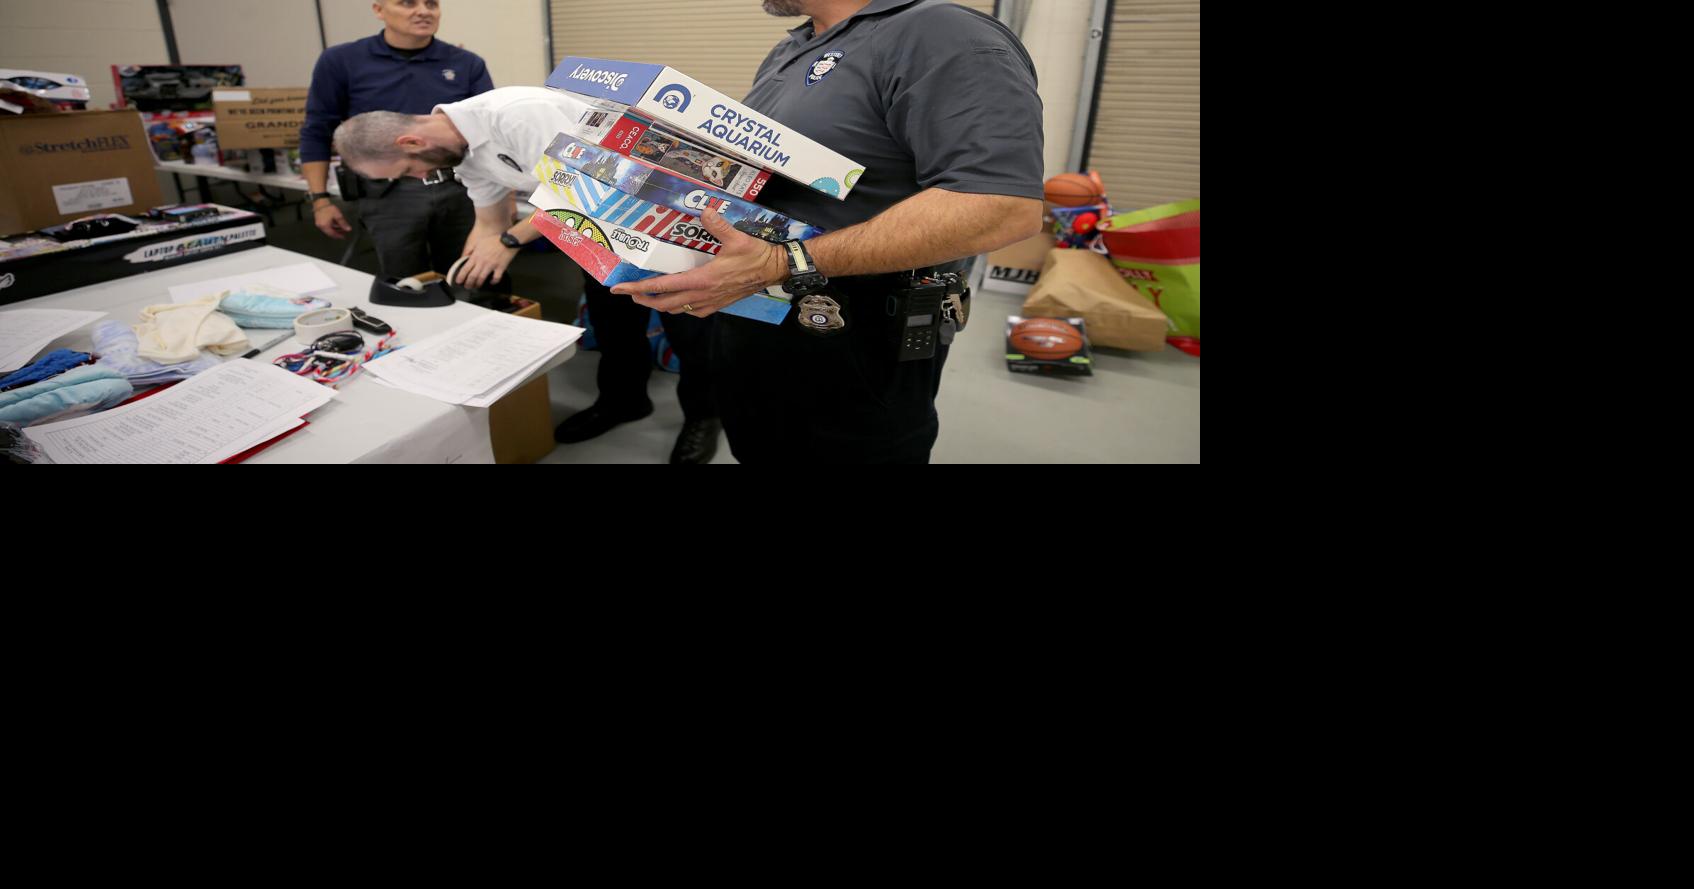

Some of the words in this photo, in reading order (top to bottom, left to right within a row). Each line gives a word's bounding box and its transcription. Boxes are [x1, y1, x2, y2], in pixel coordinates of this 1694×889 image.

[568, 64, 628, 91] Discovery
[710, 104, 781, 147] CRYSTAL
[562, 142, 586, 159] CLUE
[697, 119, 791, 167] AQUARIUM
[749, 177, 767, 196] 550
[684, 189, 732, 214] CLUE
[610, 228, 650, 252] TROUBLE
